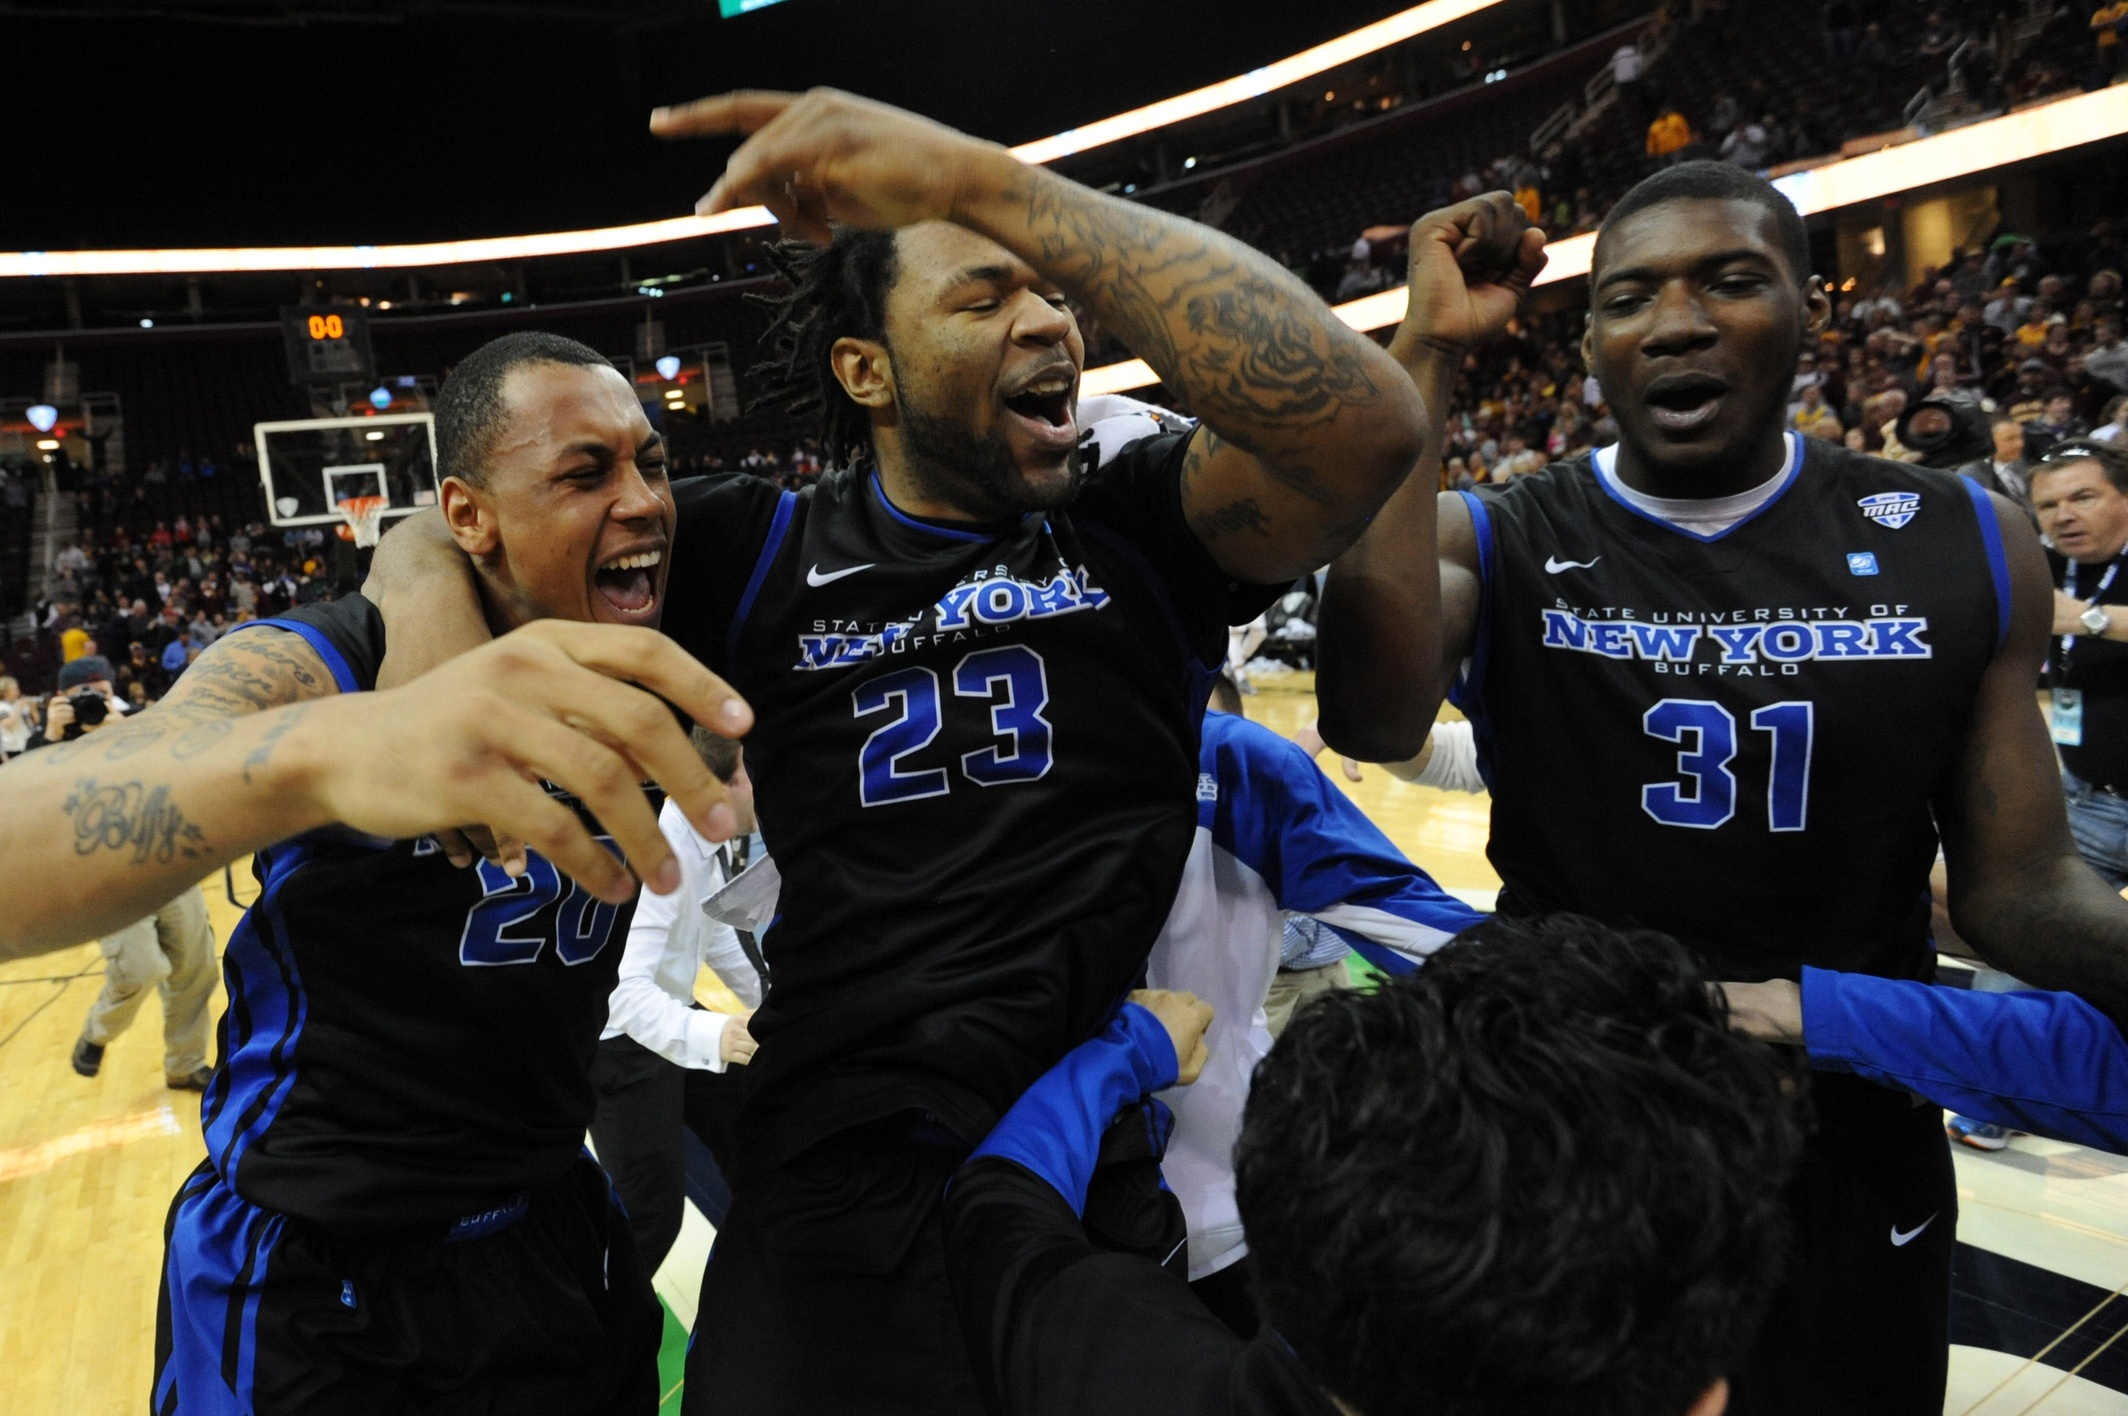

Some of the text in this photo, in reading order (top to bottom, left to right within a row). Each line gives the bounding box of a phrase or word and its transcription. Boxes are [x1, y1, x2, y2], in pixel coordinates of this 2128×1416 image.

[1862, 501, 1921, 517] MAC
[934, 564, 1111, 632] YORK
[1556, 598, 1909, 624] STATE UNIVERSITY OF
[877, 624, 1010, 657] UFFALO
[1541, 608, 1932, 664] NEW YORK
[1655, 662, 1799, 677] BUFFALO
[851, 643, 1054, 808] 23
[1641, 698, 1813, 832] 31
[459, 835, 627, 967] 20
